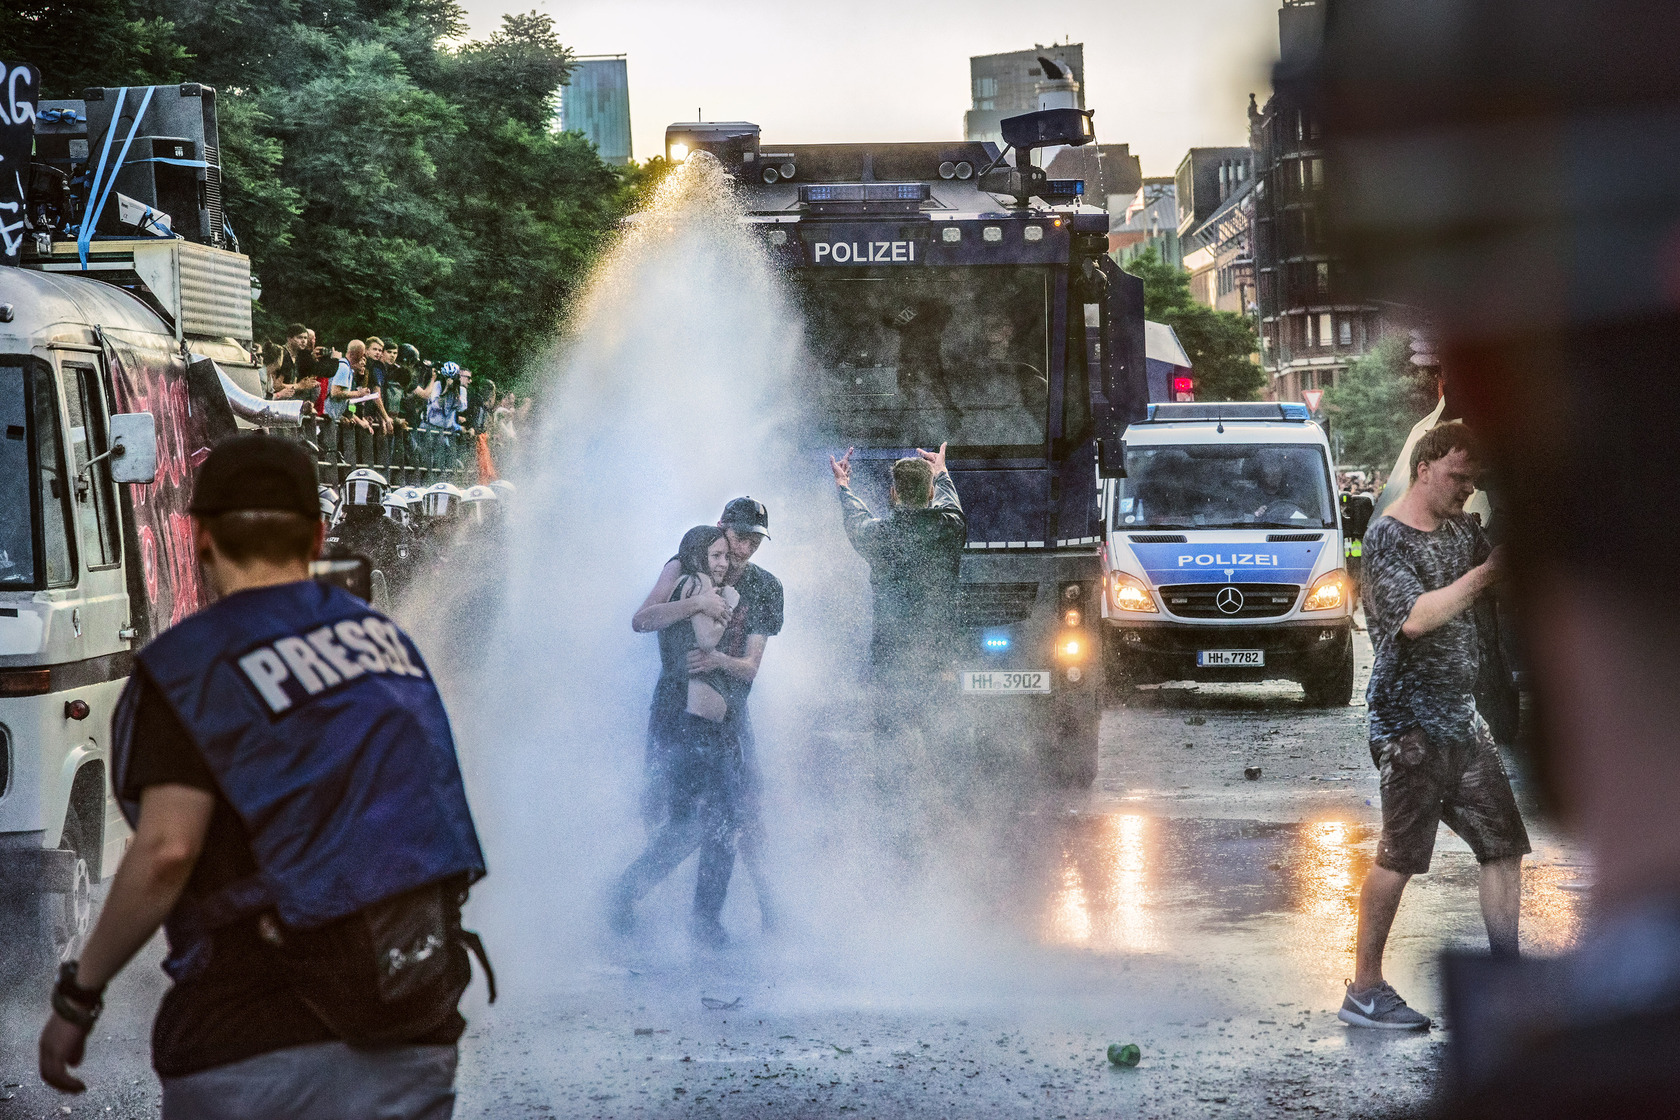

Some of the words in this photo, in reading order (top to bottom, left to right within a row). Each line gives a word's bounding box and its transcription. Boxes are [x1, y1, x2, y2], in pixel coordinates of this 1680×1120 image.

[814, 241, 915, 263] POLIZEI
[1178, 553, 1278, 567] POLIZEI
[1208, 652, 1223, 664] HH
[1231, 652, 1259, 663] 7782
[972, 673, 993, 689] HH
[1003, 673, 1042, 689] 3902
